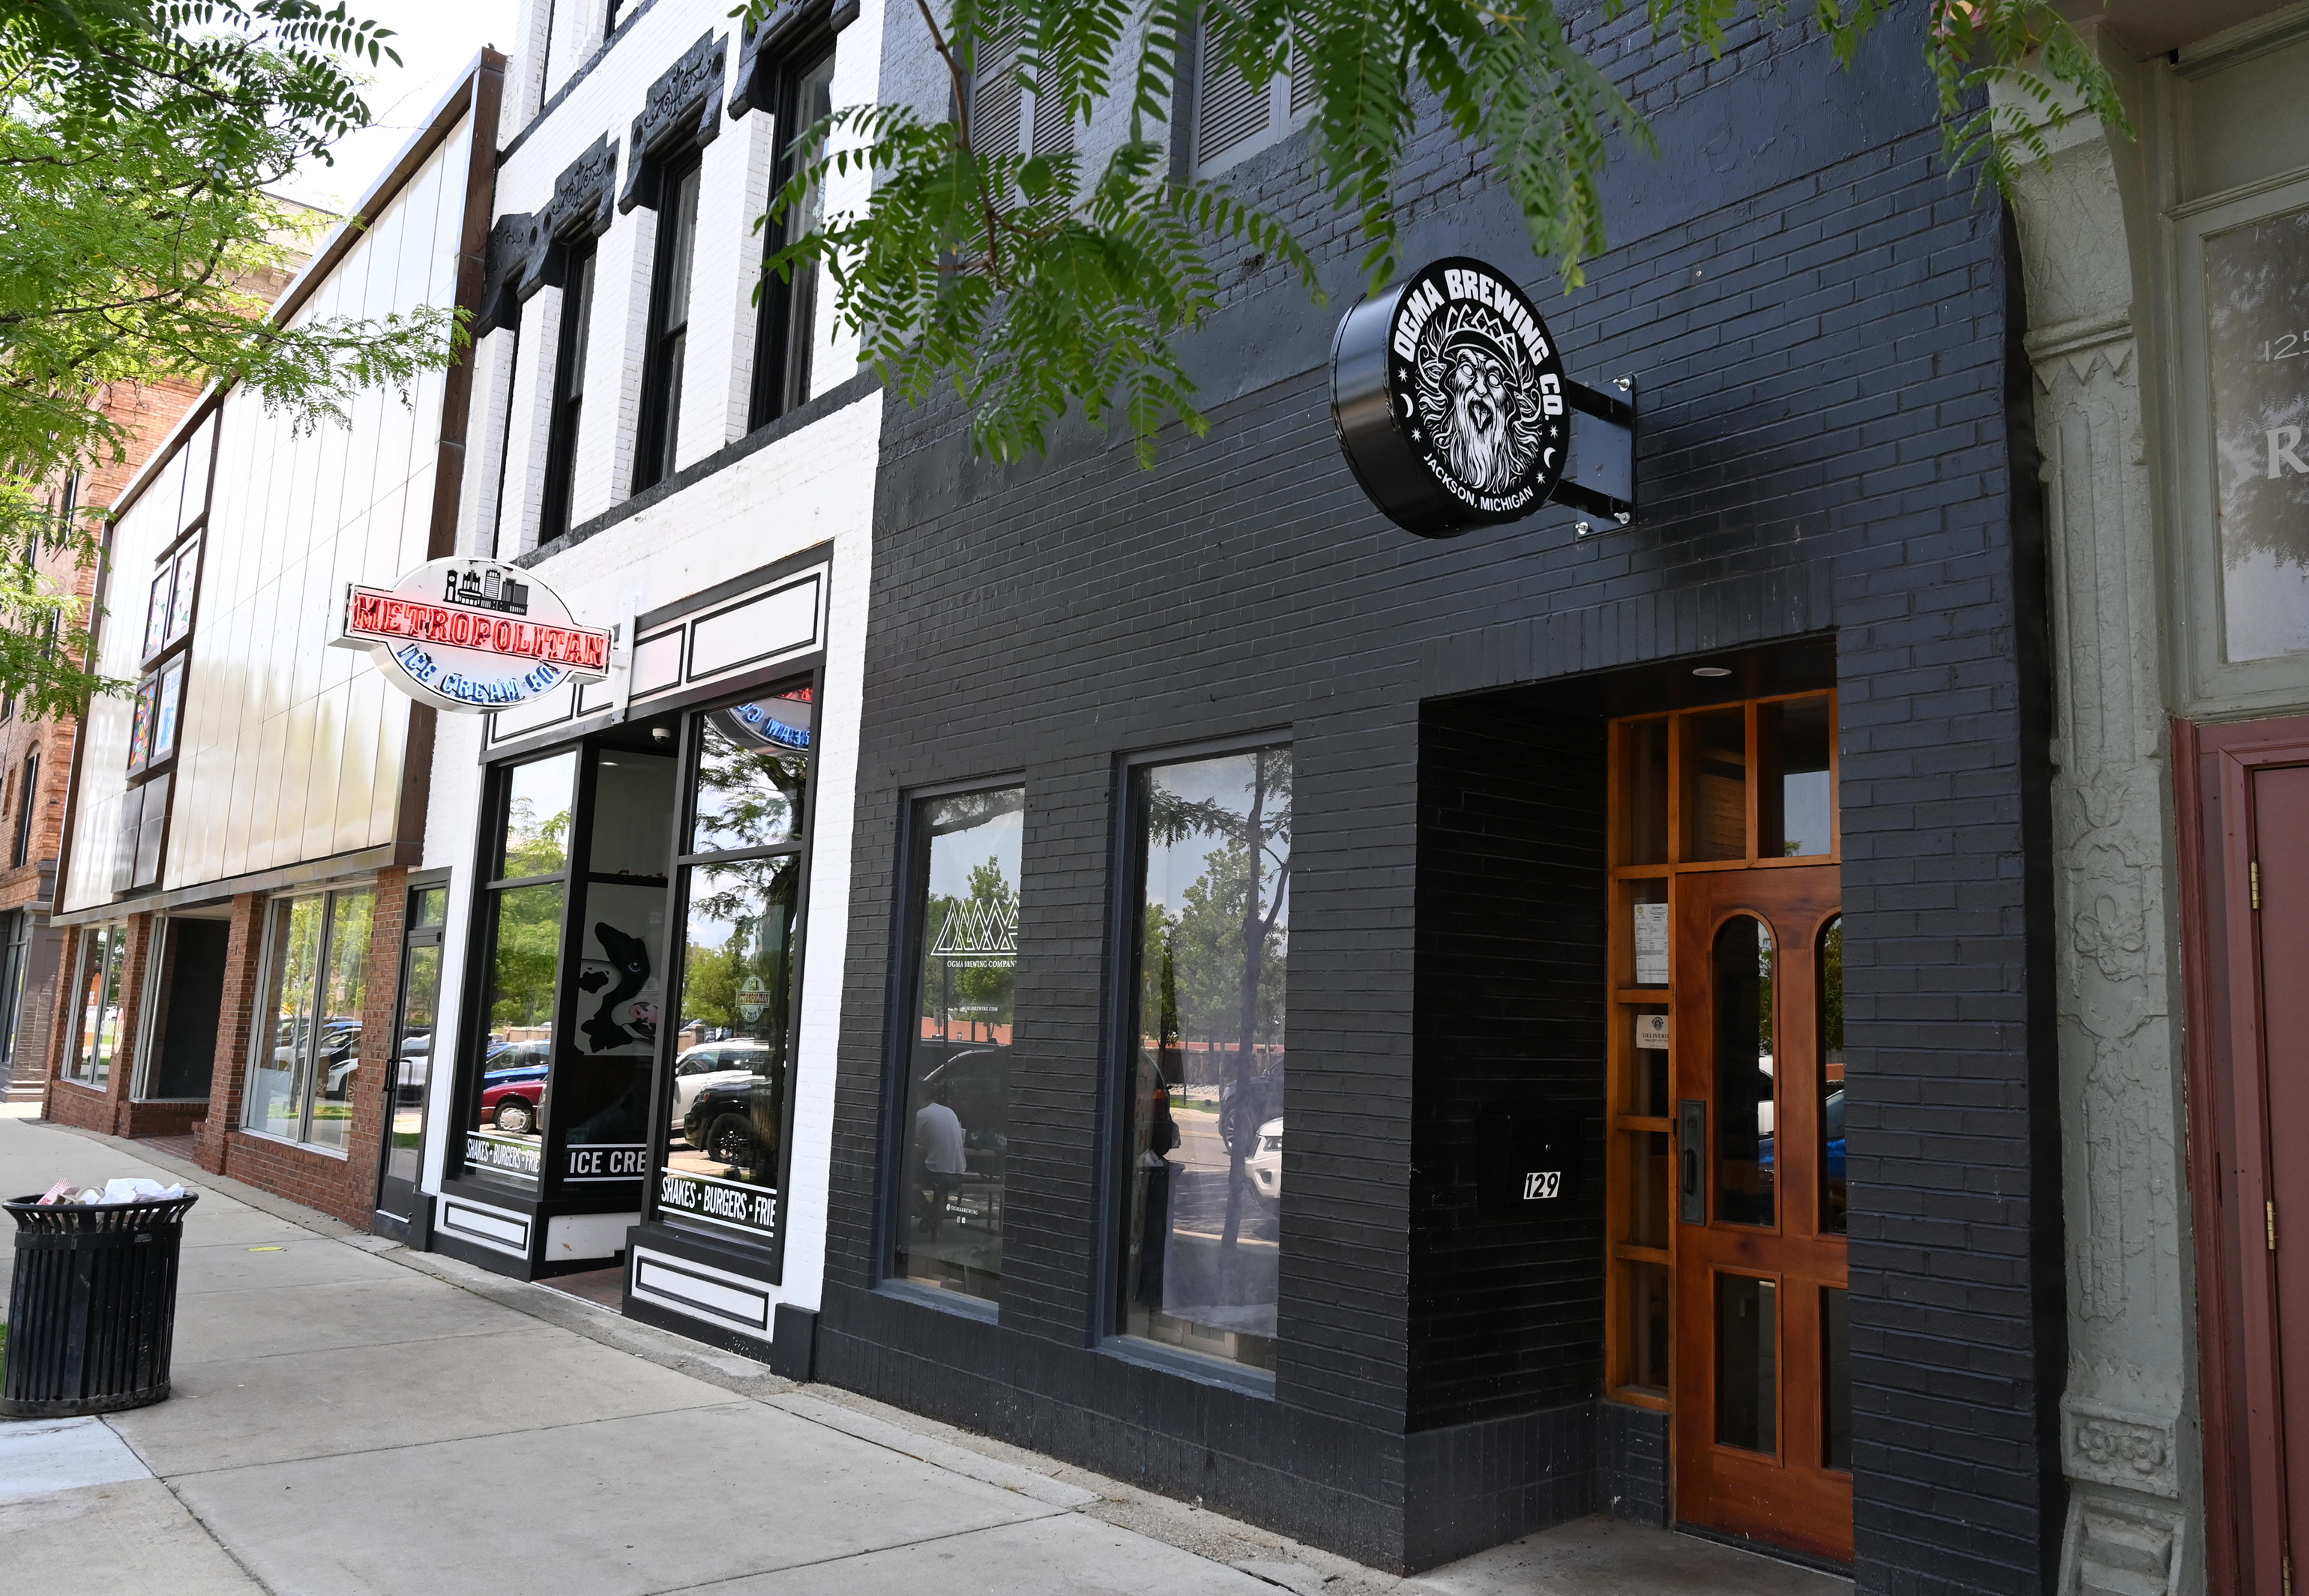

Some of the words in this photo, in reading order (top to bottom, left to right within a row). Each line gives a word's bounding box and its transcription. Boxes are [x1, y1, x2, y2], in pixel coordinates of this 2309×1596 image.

[1393, 278, 1445, 364] OGMA
[1444, 268, 1550, 367] BREWING
[1539, 373, 1563, 421] CO.
[2266, 330, 2309, 361] 12
[1423, 453, 1478, 509] JACKSON,
[1480, 485, 1534, 512] MICHIGAN
[352, 594, 604, 667] METROPOLITAN
[397, 643, 439, 682] ICE
[440, 672, 521, 702] CREAM
[466, 1138, 490, 1162] SHAKES
[493, 1143, 522, 1169] BURGERS
[570, 1151, 603, 1174] ICE
[609, 1151, 646, 1173] CRE
[660, 1176, 696, 1209] SHAKES
[703, 1184, 747, 1221] BURGERS
[753, 1196, 777, 1227] FRIE
[1526, 1172, 1559, 1199] 129
